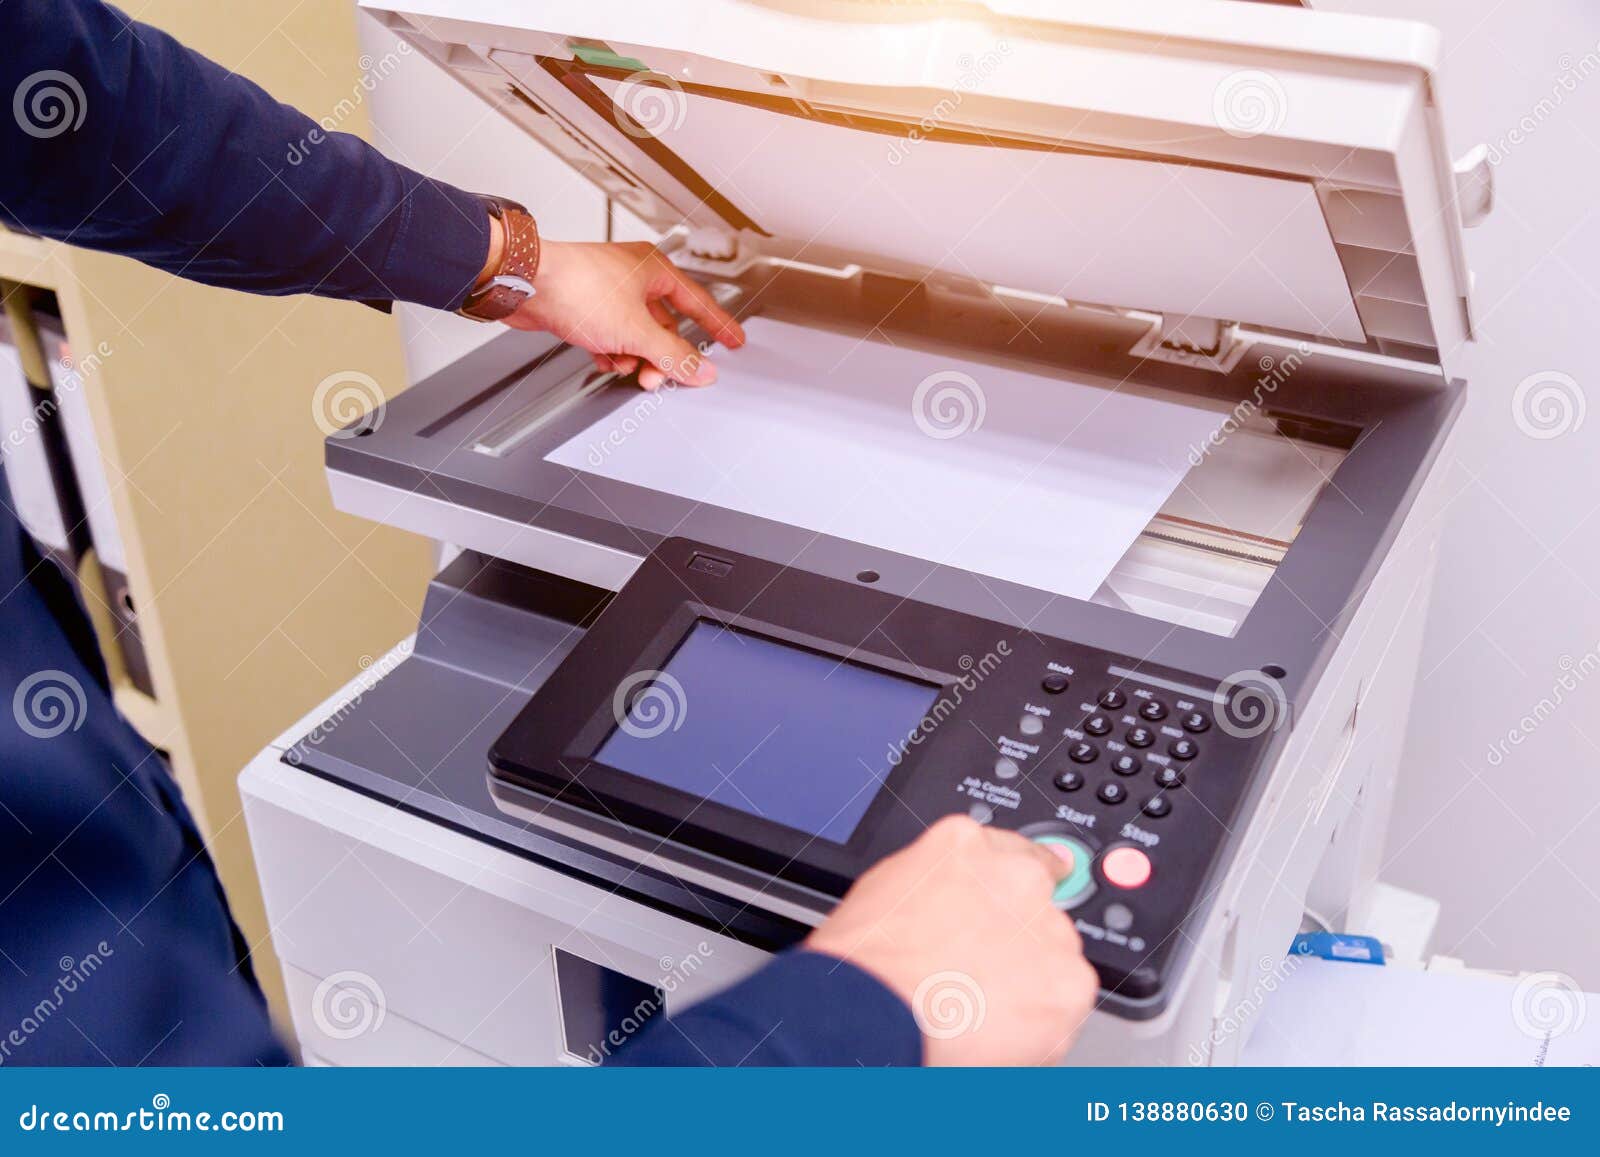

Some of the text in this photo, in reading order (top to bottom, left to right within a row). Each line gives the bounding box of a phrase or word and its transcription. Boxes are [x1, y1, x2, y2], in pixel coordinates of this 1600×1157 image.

[1047, 662, 1074, 675] Mode
[1108, 691, 1116, 702] 1
[1147, 702, 1159, 714] 2
[1090, 718, 1103, 729] 4
[1190, 713, 1202, 726] 3
[1134, 729, 1146, 741] 5
[1078, 743, 1090, 756] 7
[1176, 741, 1190, 753] 6
[1119, 756, 1133, 769] 8
[1104, 784, 1118, 798] 0
[1055, 804, 1096, 827] Start
[1120, 822, 1160, 847] Stop
